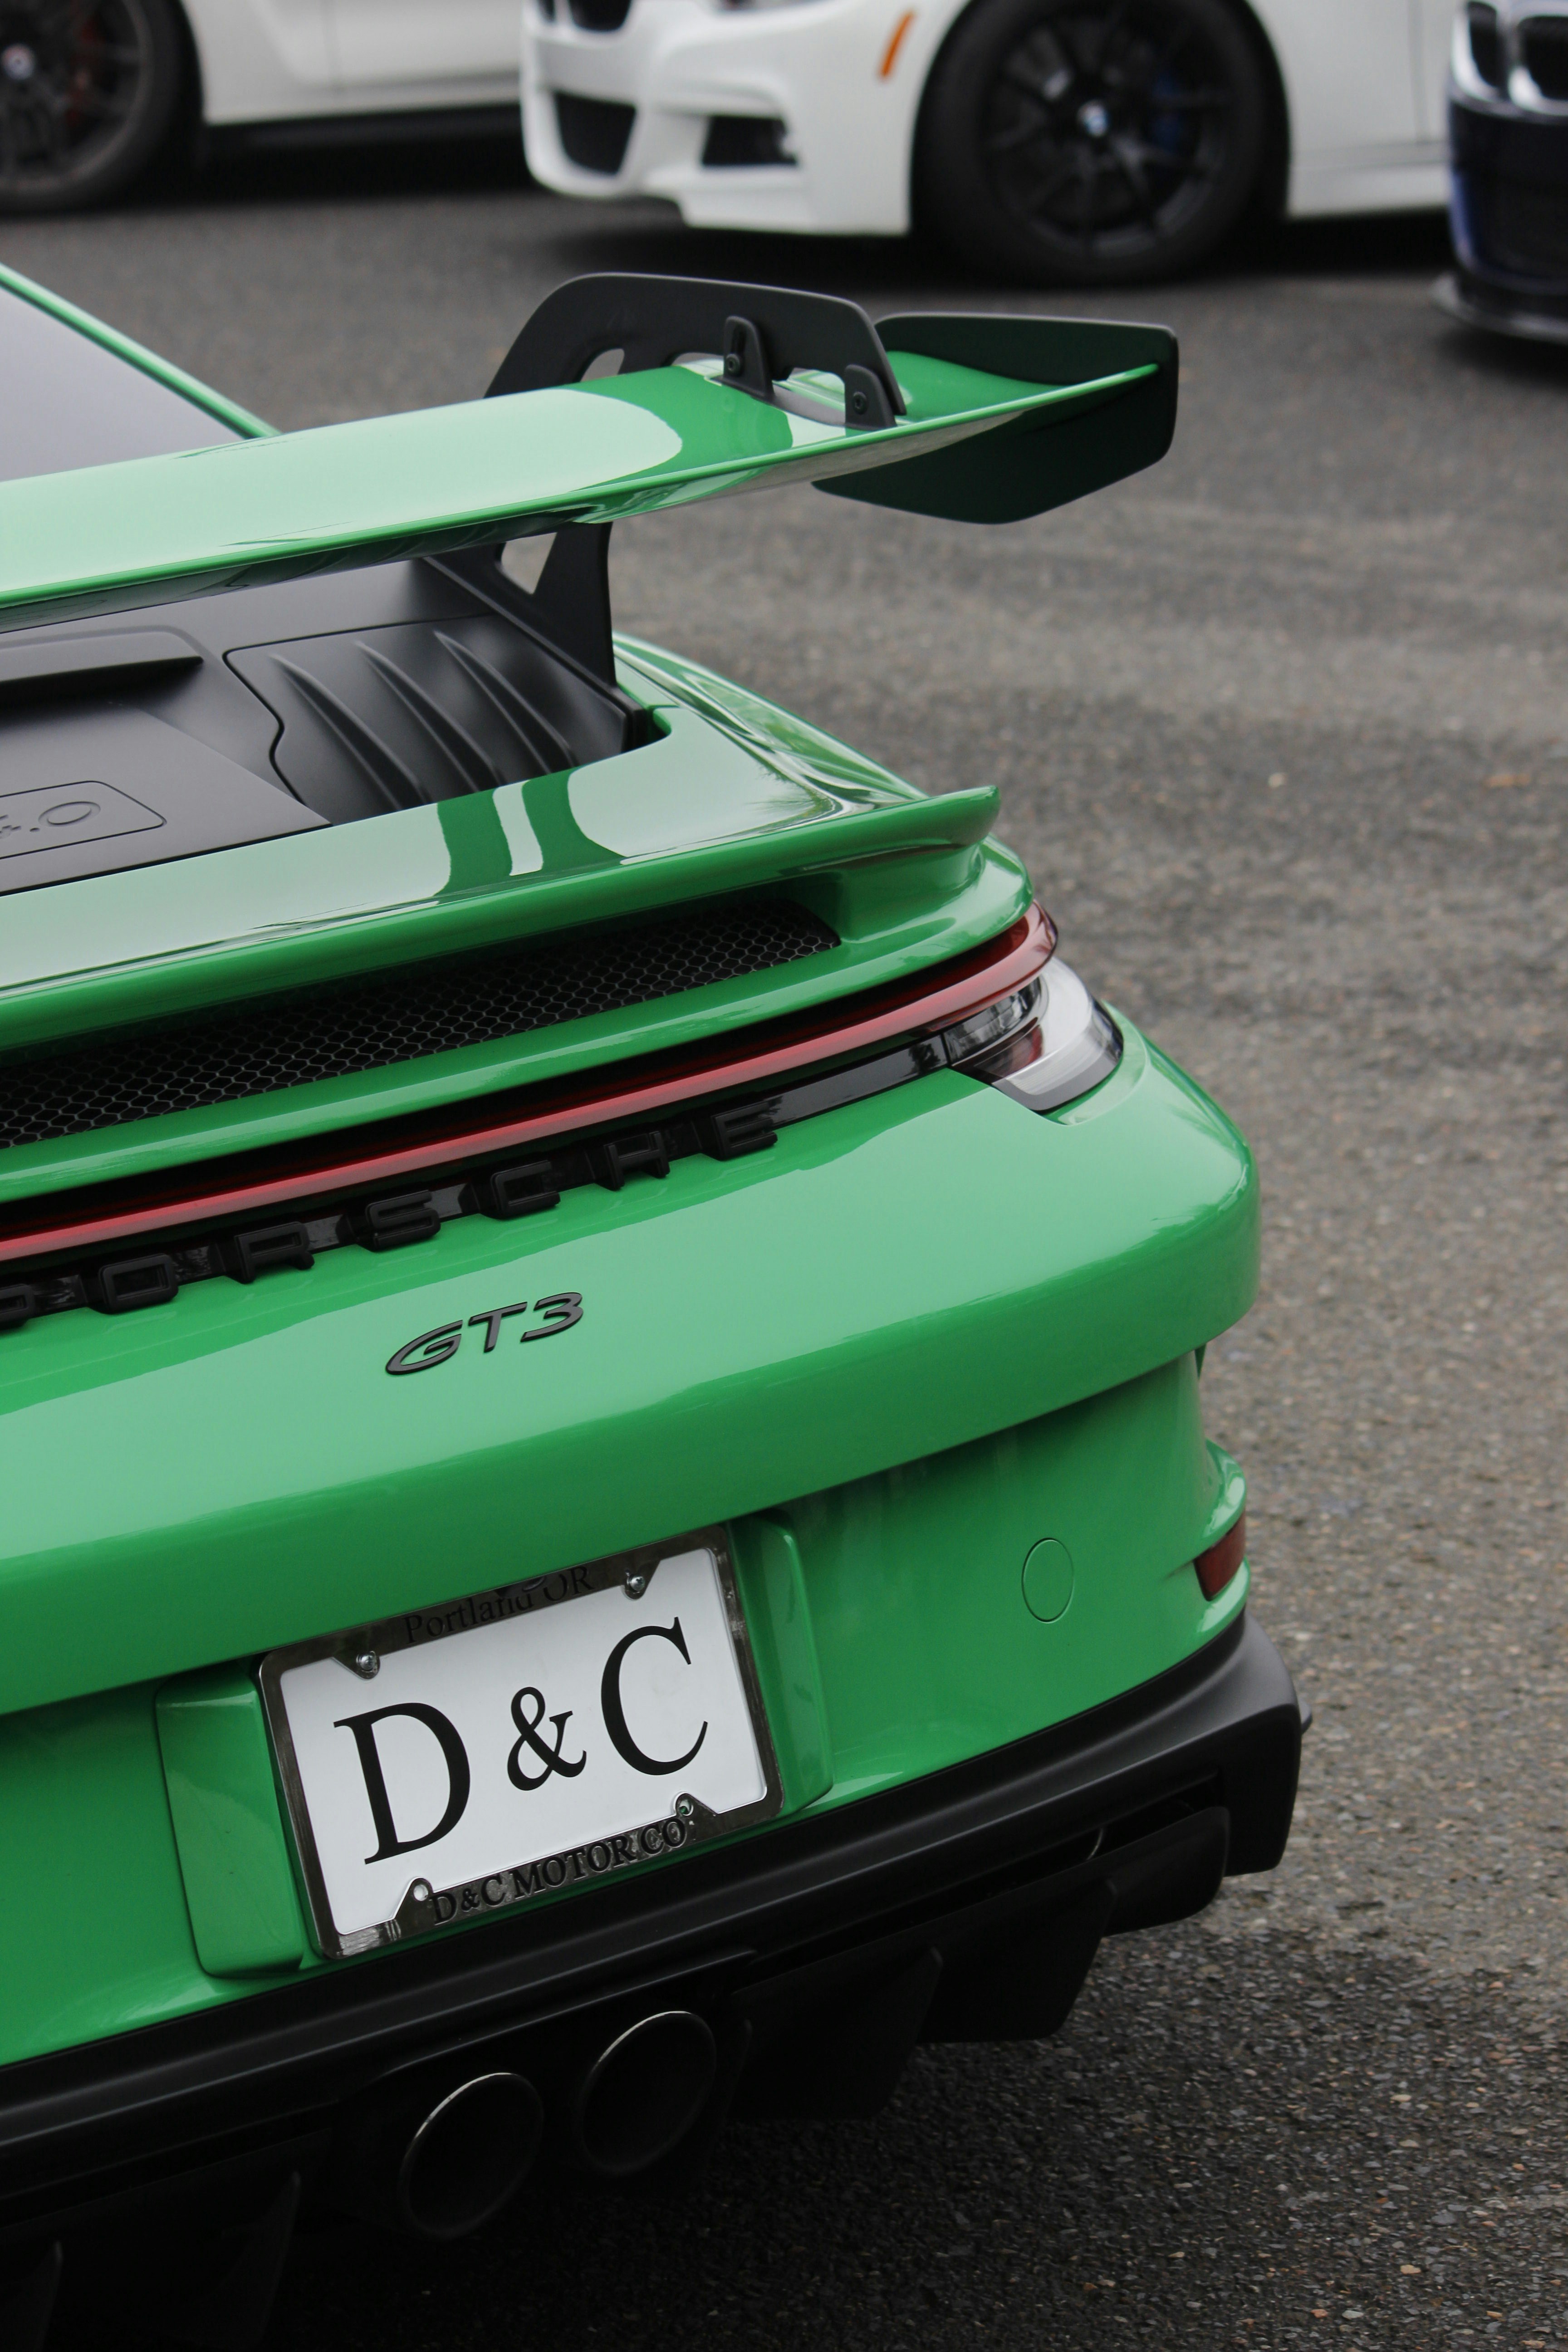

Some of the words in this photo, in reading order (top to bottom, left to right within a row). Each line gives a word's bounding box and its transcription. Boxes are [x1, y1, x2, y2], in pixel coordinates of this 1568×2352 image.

[385, 1292, 583, 1375] GT3
[402, 1588, 534, 1644] Portland
[544, 1565, 595, 1602] OR
[333, 1702, 470, 1865] D
[507, 1687, 587, 1791] &
[601, 1617, 708, 1776] C
[429, 1874, 506, 1926] D&C
[509, 1835, 637, 1899] MOTOR
[640, 1817, 687, 1855] CO
